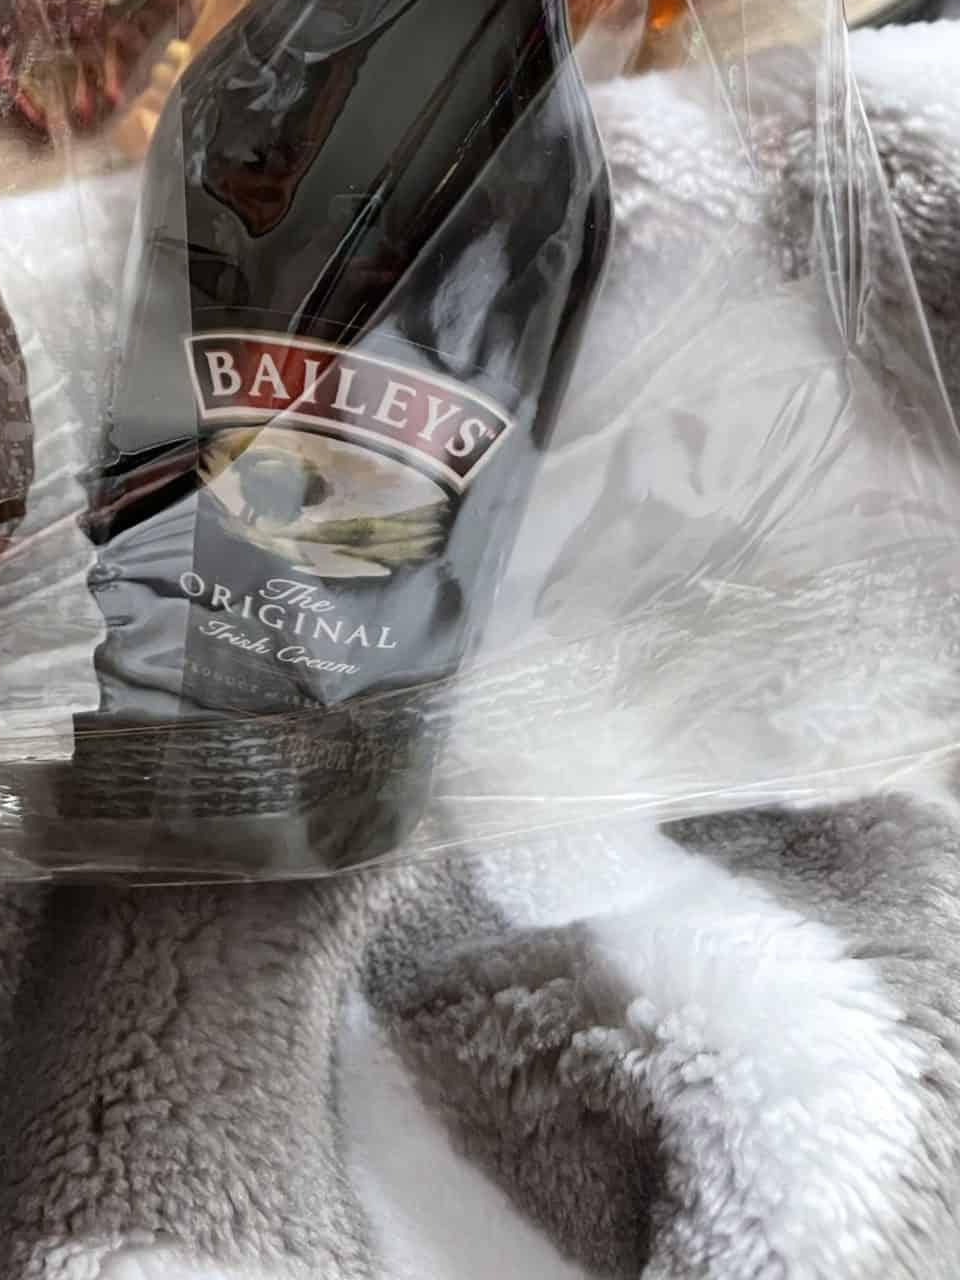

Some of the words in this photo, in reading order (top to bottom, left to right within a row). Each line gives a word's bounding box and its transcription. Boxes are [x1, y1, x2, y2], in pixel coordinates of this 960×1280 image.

[205, 350, 489, 457] BAILEYS
[180, 572, 399, 648] ORIGINAL
[259, 578, 335, 612] The
[199, 620, 273, 655] Irish
[276, 646, 360, 674] Cream
